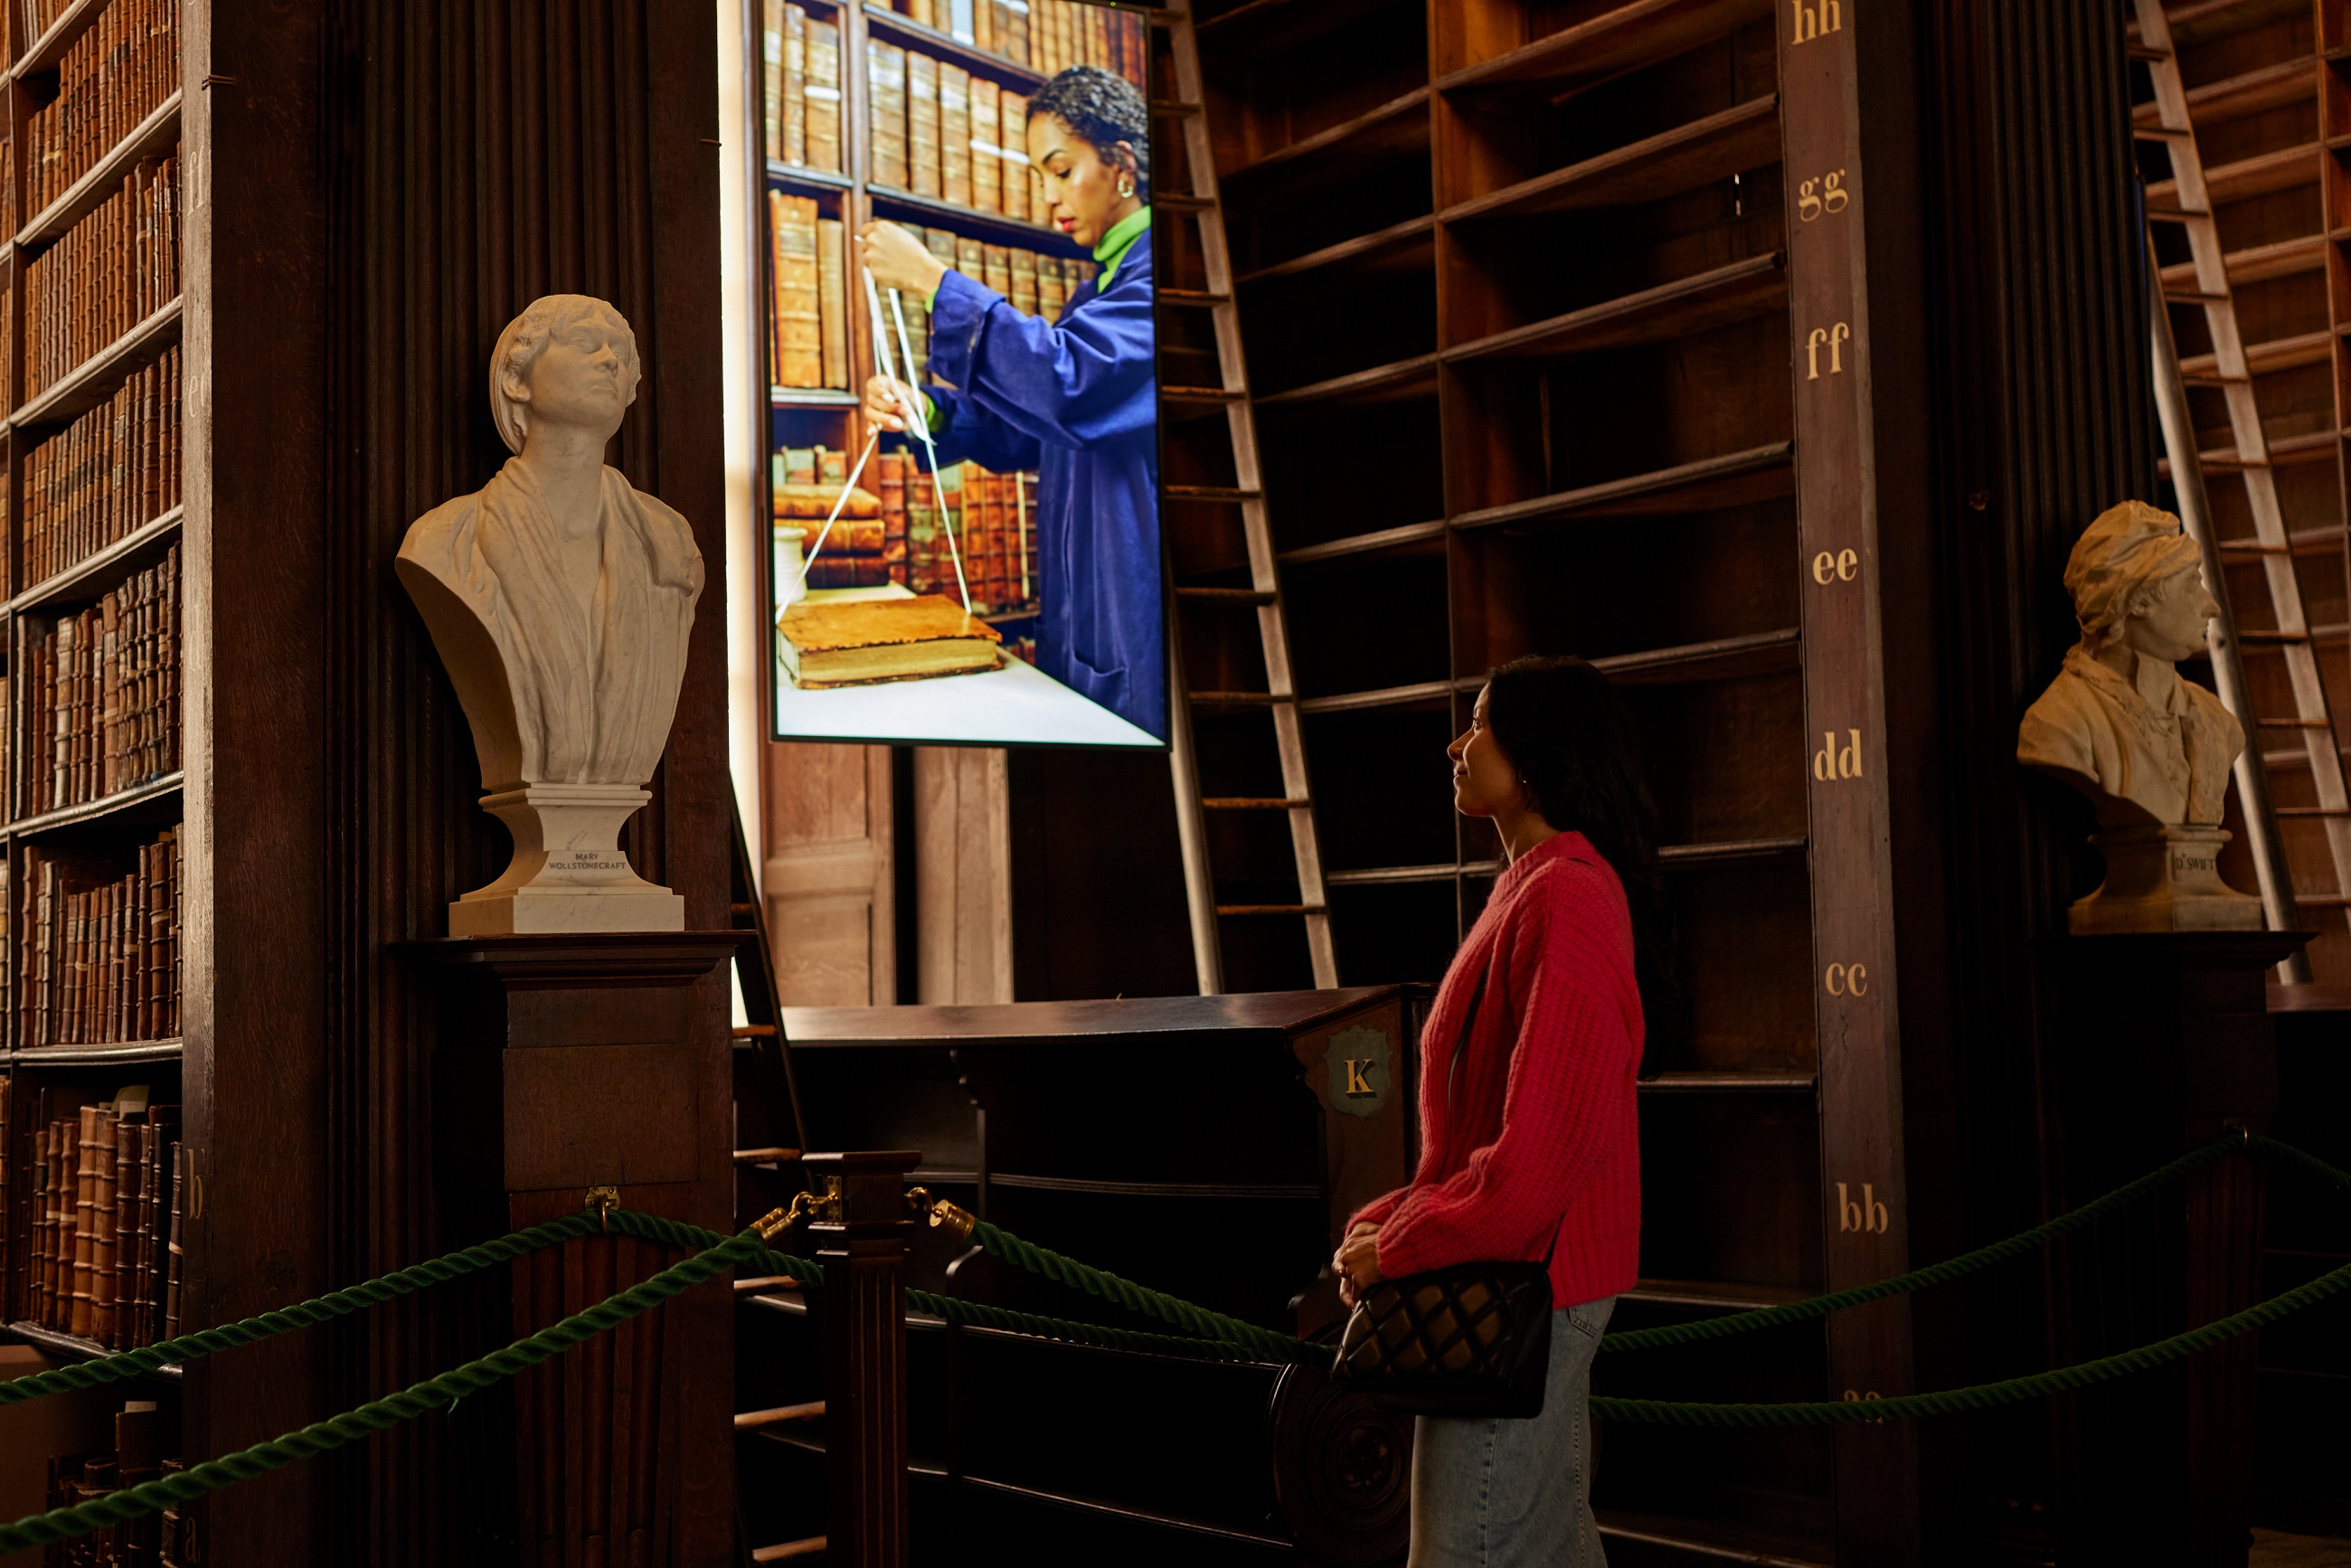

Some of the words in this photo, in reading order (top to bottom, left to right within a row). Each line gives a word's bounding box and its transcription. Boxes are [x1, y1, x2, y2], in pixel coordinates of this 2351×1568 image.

[1798, 168, 1849, 223] gg
[1805, 322, 1850, 381] ff
[1812, 548, 1858, 585] ee
[1813, 729, 1863, 781] dd
[549, 862, 626, 870] WOLLSTONECRAFT
[2187, 858, 2215, 871] SWIFT
[1825, 962, 1867, 997] cc
[1344, 1059, 1376, 1096] K
[1836, 1182, 1889, 1235] bb
